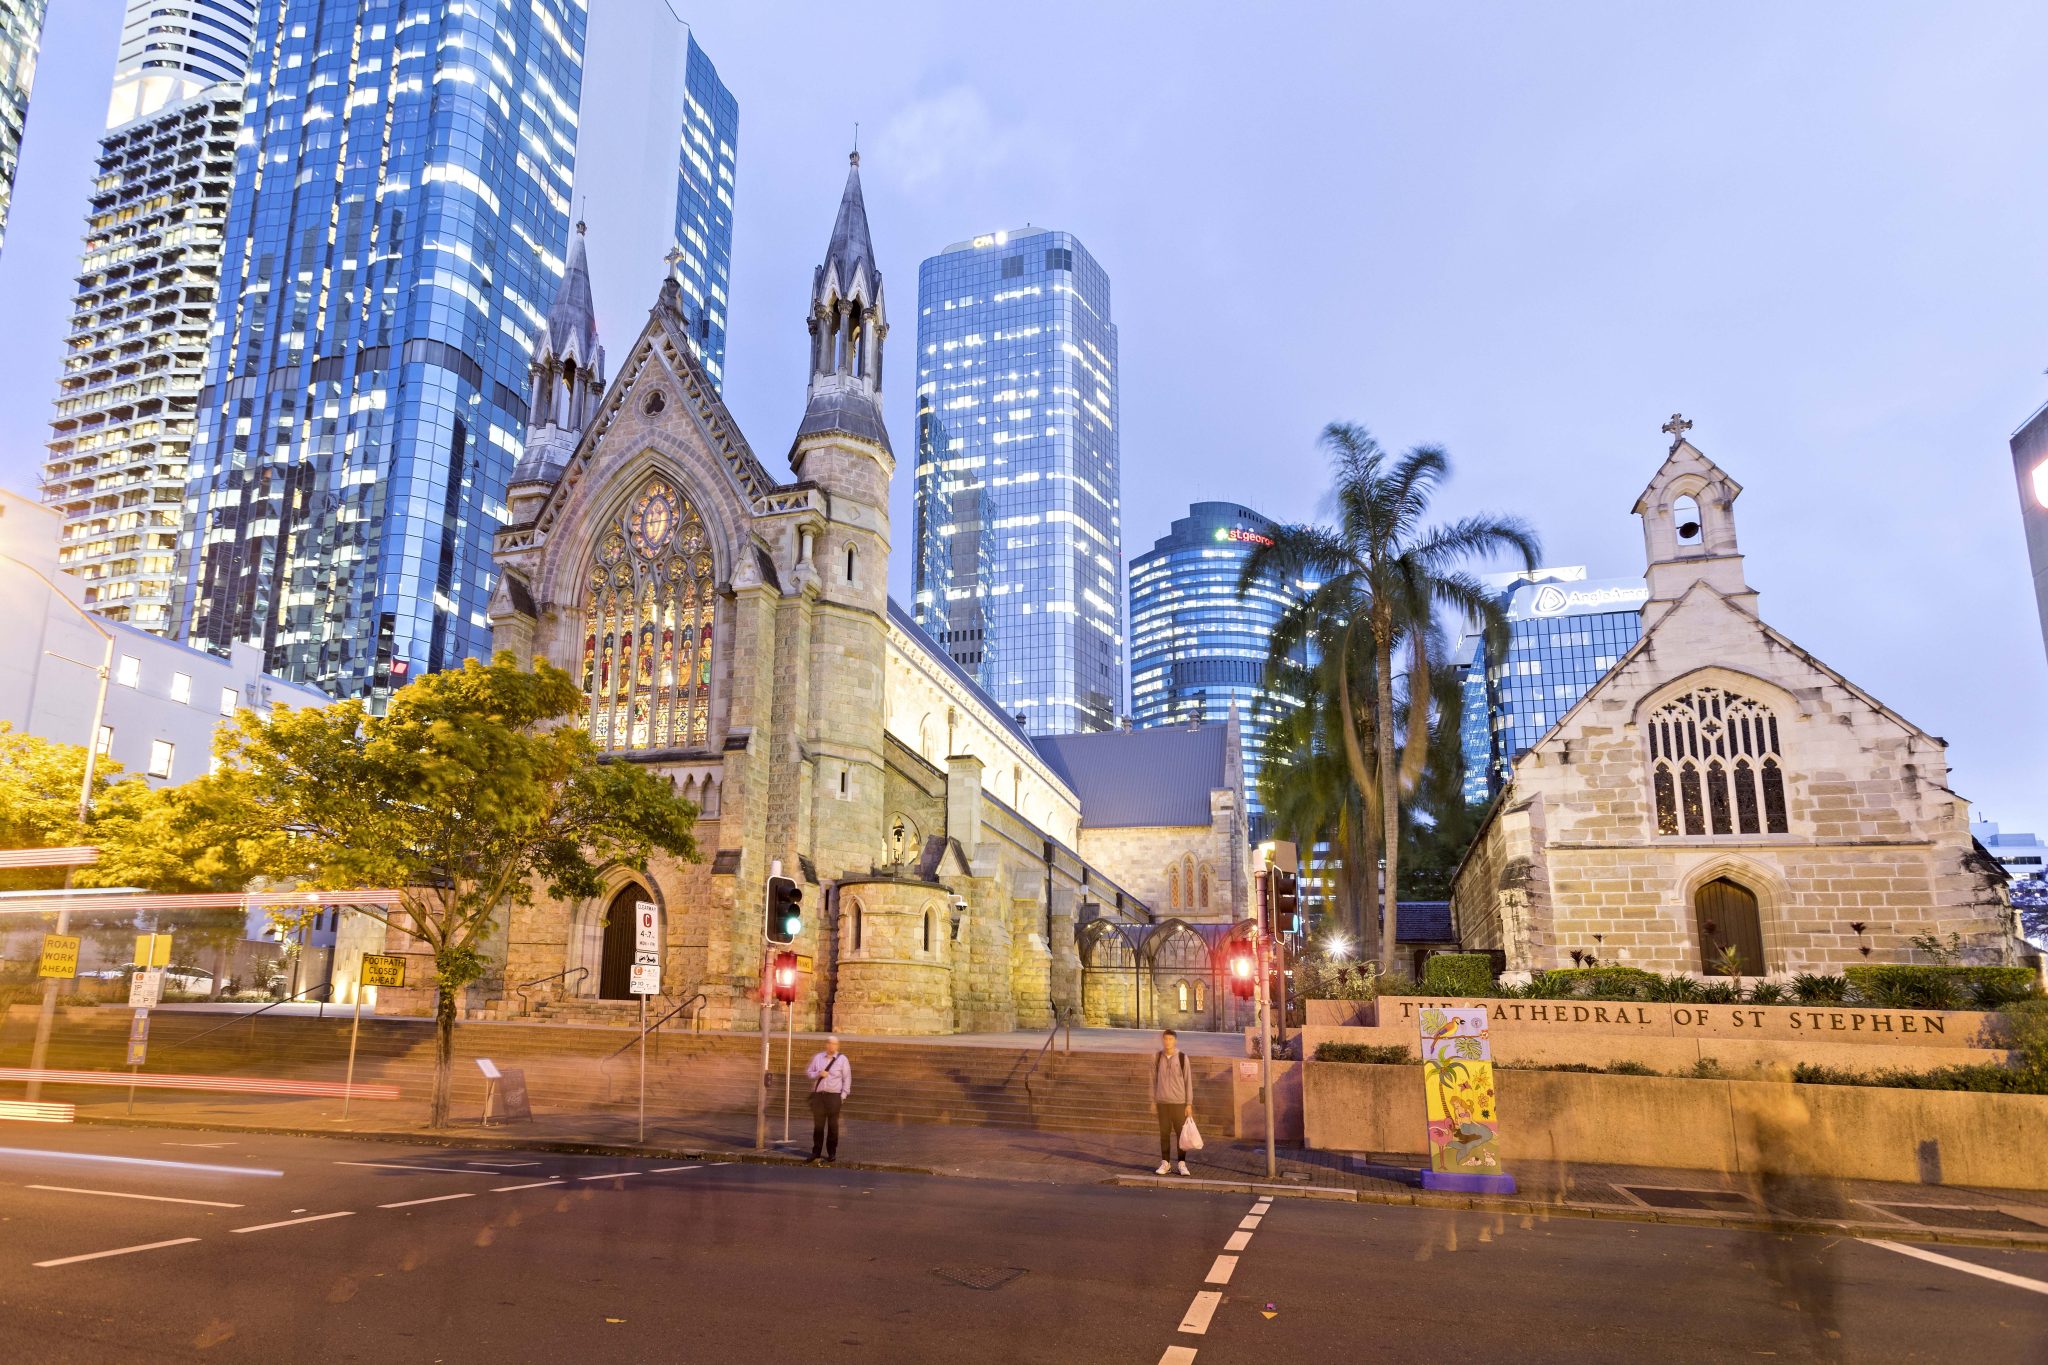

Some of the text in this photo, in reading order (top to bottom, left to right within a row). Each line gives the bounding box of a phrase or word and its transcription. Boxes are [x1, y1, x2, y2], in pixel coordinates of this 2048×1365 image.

[47, 940, 76, 949] ROAD
[45, 953, 74, 961] WORK
[364, 957, 404, 966] FOOTPATH
[41, 965, 74, 973] AHEAD
[369, 967, 397, 975] CLOSED
[370, 977, 396, 985] AHEAD
[1474, 1003, 1651, 1024] ATHEDRAL
[1673, 1009, 1709, 1026] OF
[1732, 1010, 1765, 1027] ST
[1790, 1012, 1945, 1034] STEPHEN
